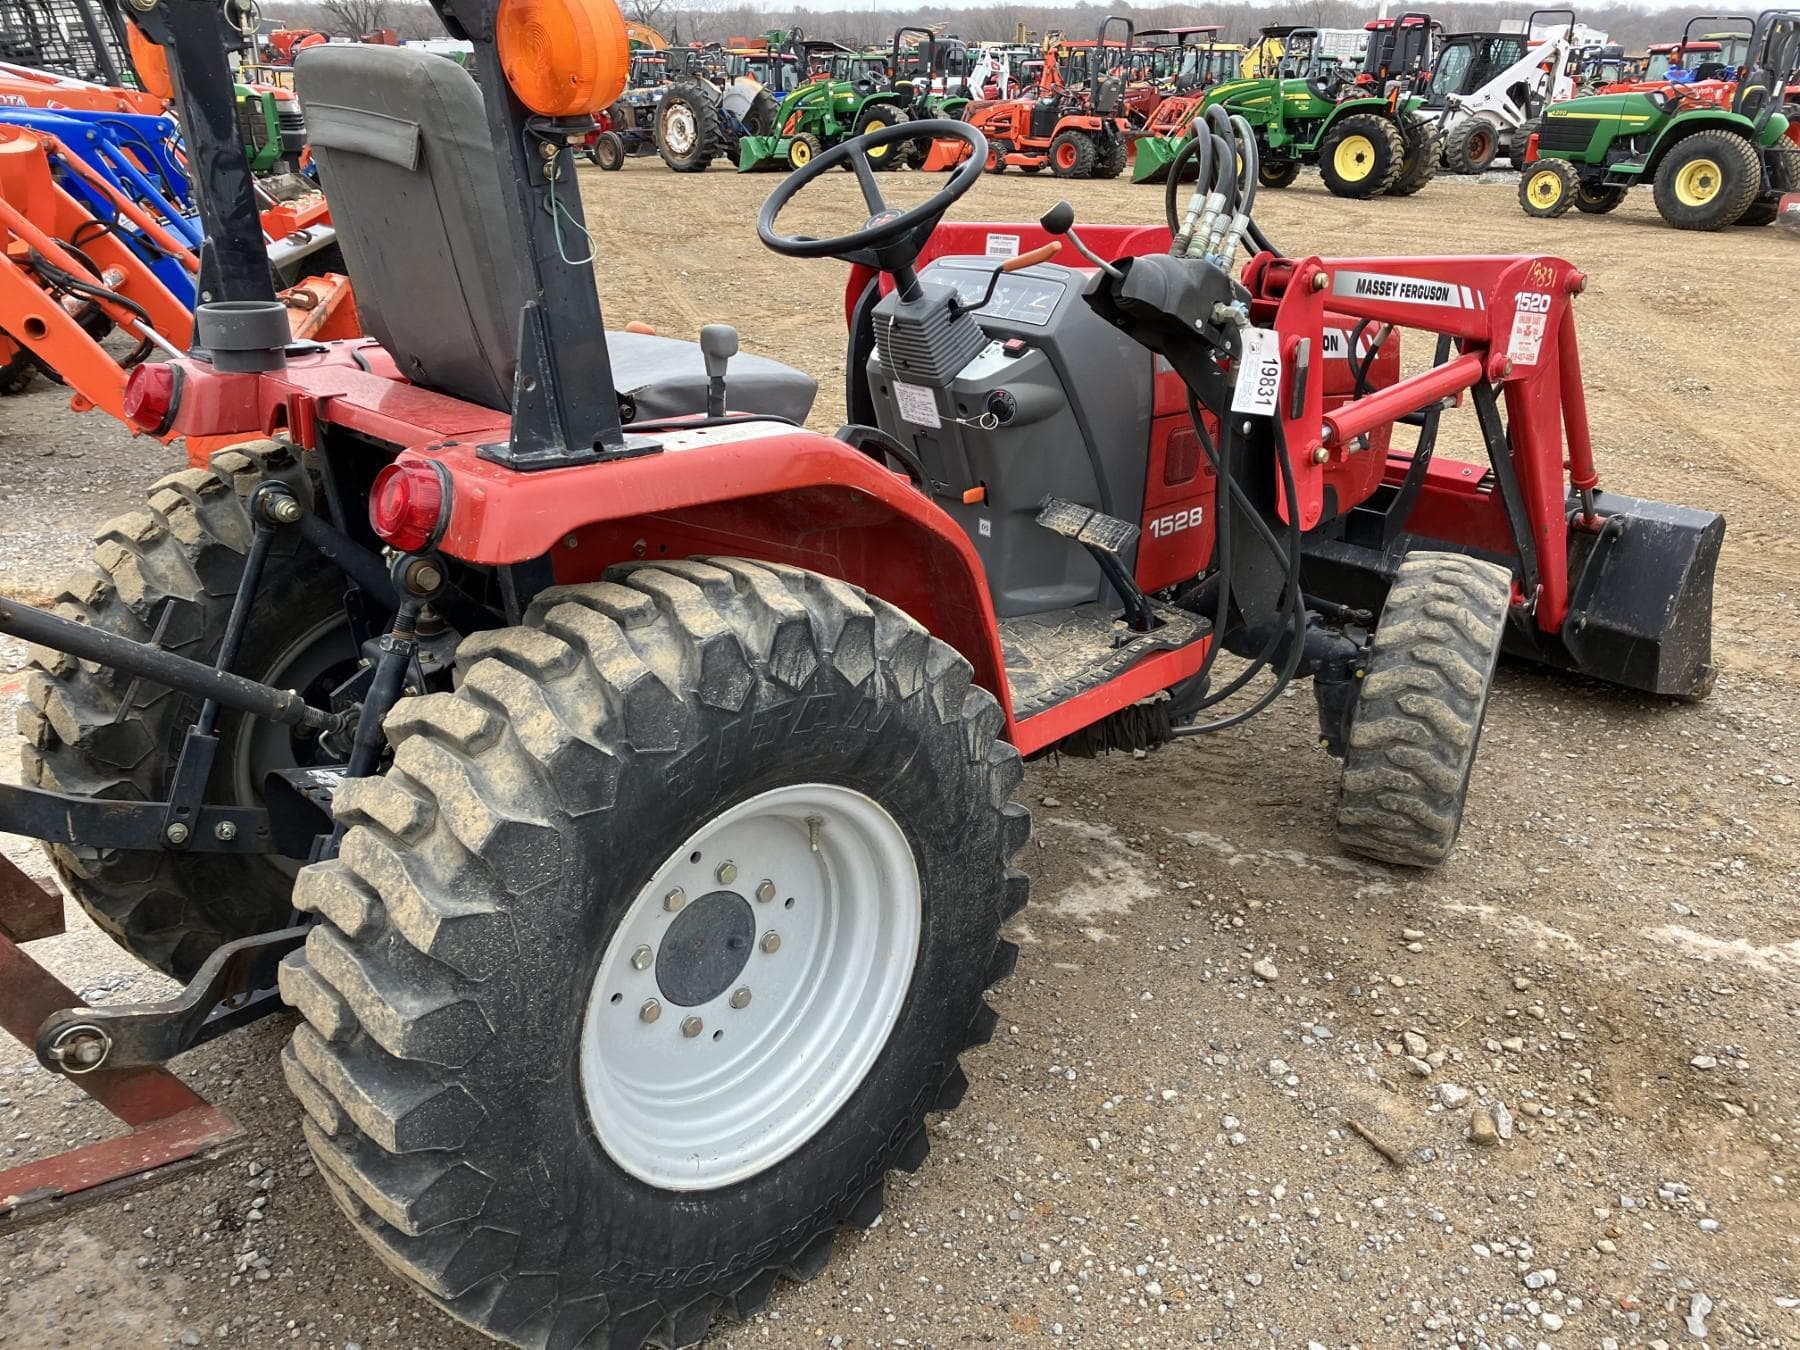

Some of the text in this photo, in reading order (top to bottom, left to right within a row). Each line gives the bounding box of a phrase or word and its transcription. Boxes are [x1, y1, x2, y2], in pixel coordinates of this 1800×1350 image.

[1355, 278, 1450, 302] MASSEY FERGUSON
[1514, 291, 1552, 314] 1520
[1255, 358, 1279, 407] 19831
[1149, 506, 1203, 538] 1528
